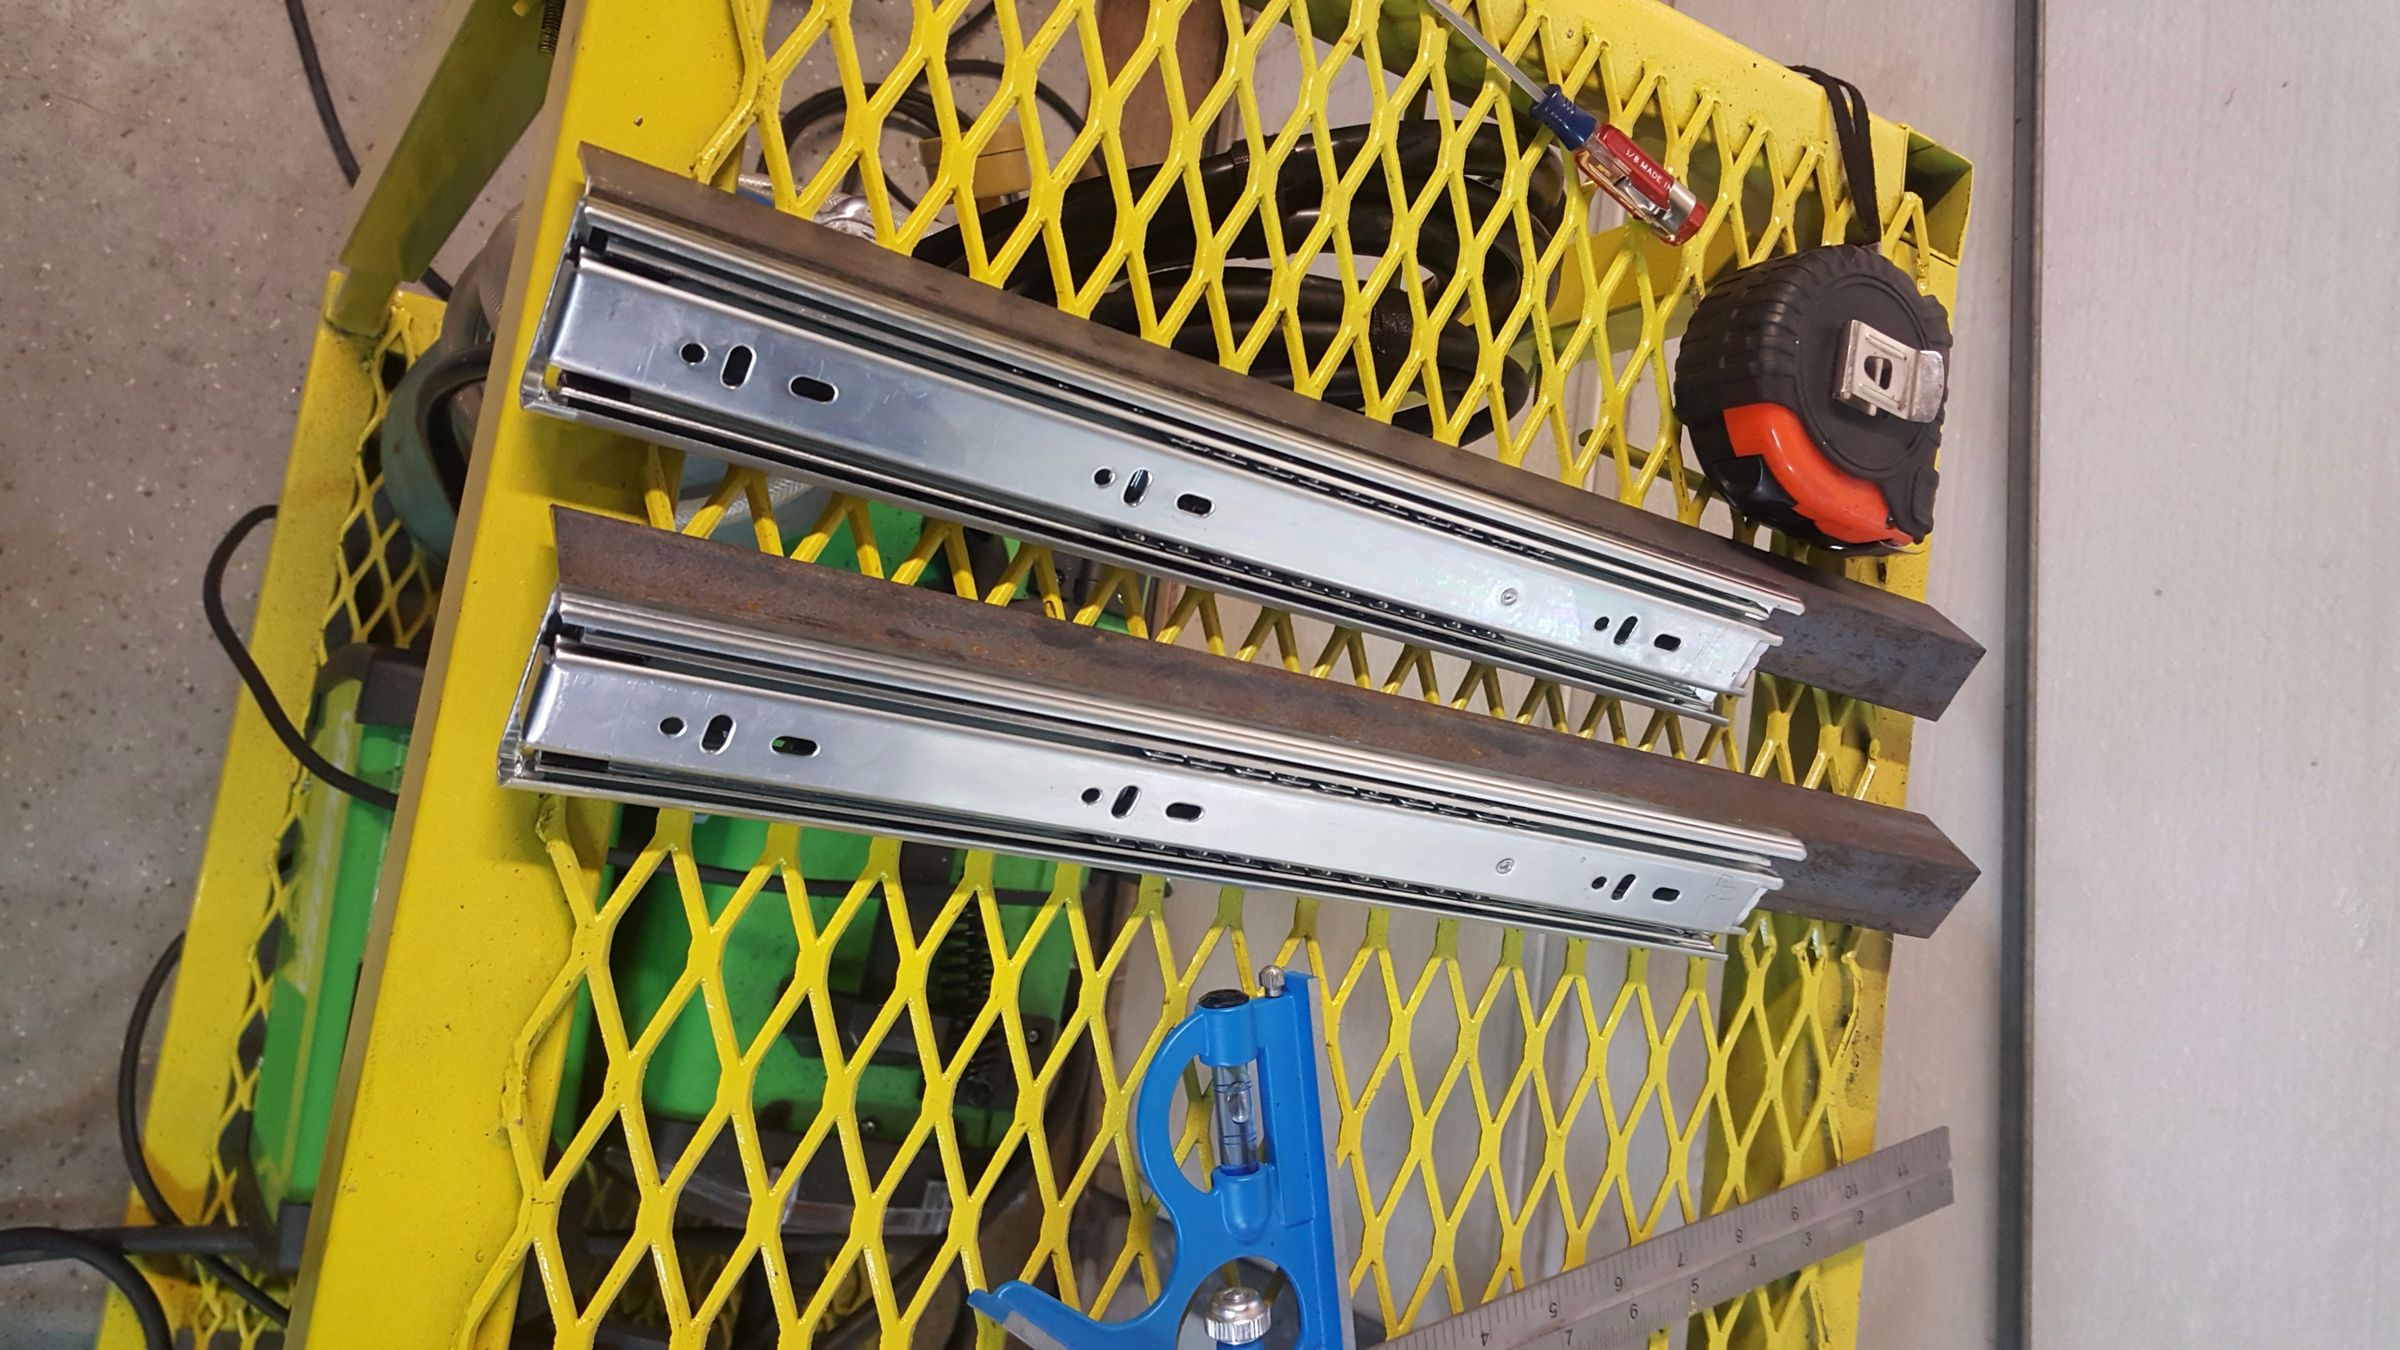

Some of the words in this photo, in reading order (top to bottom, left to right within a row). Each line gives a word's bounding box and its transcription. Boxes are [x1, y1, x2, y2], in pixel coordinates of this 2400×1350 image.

[1640, 161, 1663, 183] MADE
[1844, 1182, 1859, 1200] 10
[1857, 1209, 1865, 1225] 2
[1735, 1228, 1744, 1244] 8
[1803, 1231, 1813, 1247] 3
[1677, 1252, 1686, 1268] 7
[1749, 1253, 1757, 1269] 4
[1690, 1277, 1700, 1294] 5
[1549, 1302, 1558, 1319] 5
[1629, 1303, 1639, 1320] 6
[1480, 1331, 1490, 1347] 4
[1565, 1329, 1573, 1347] 7
